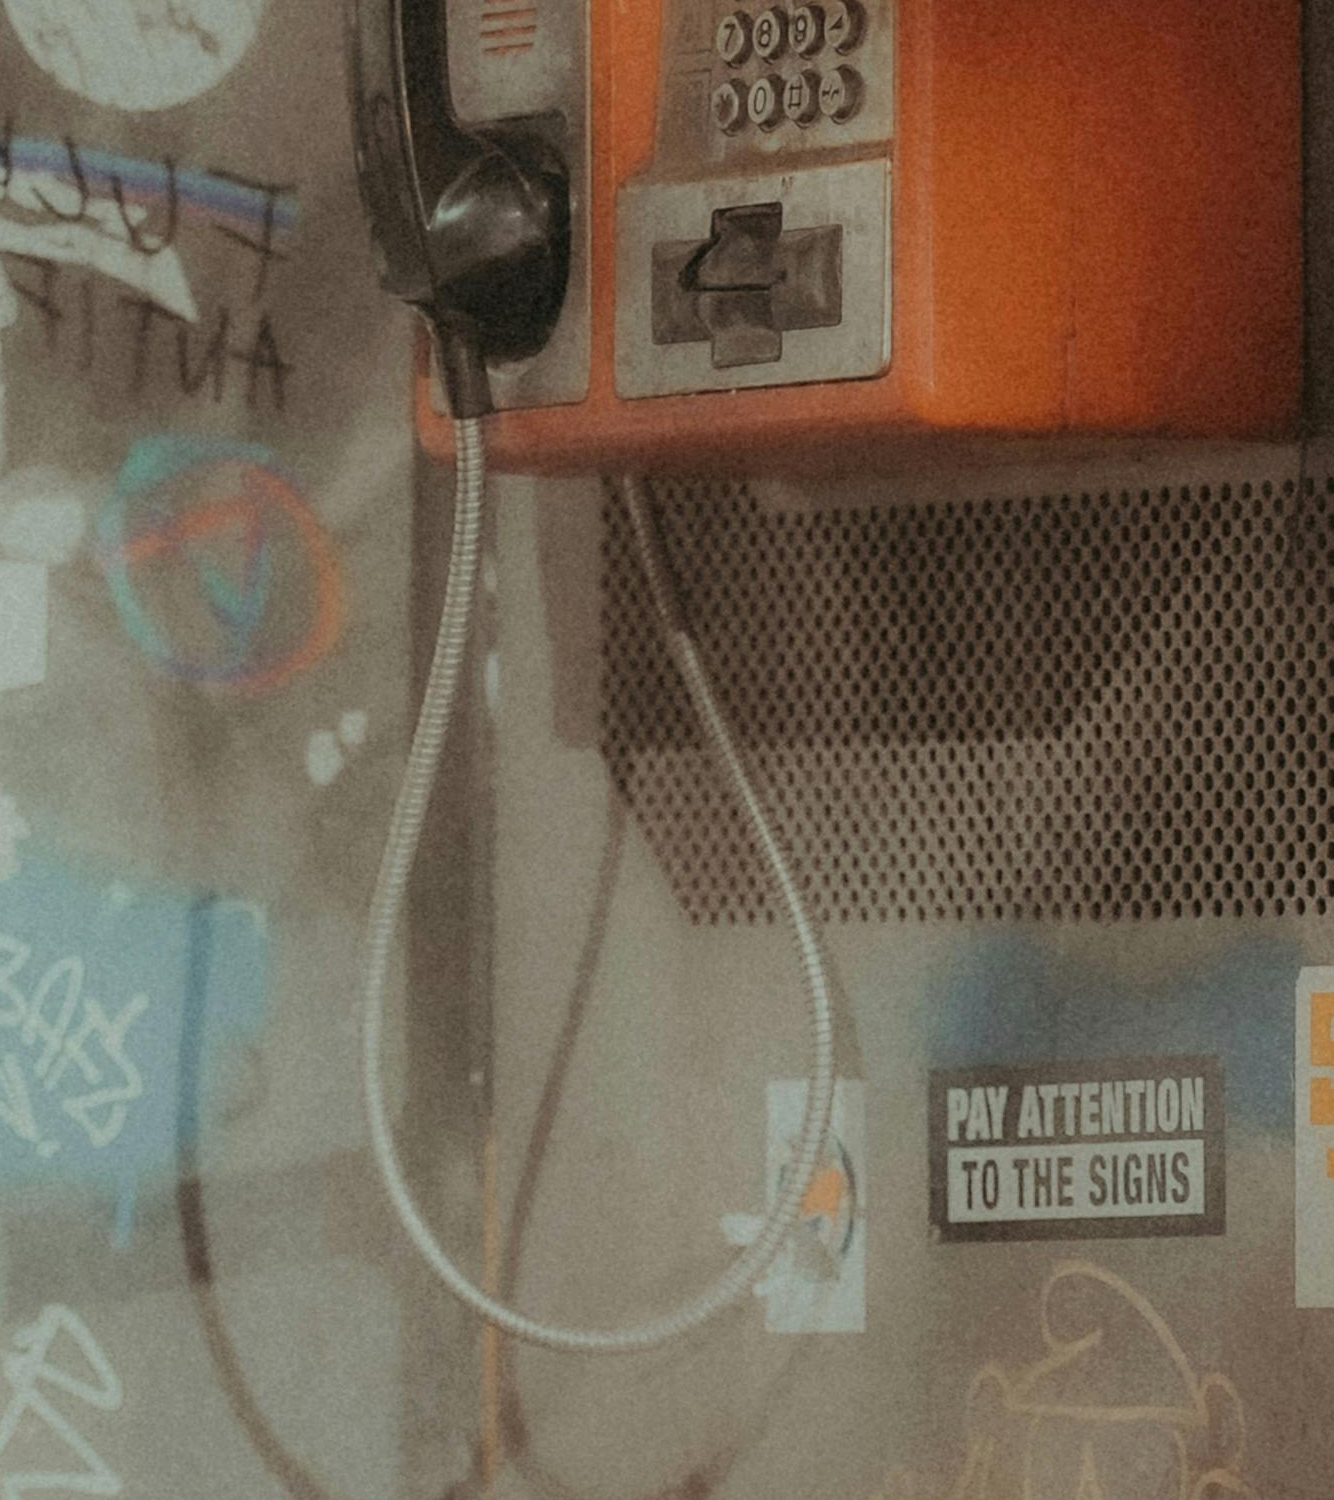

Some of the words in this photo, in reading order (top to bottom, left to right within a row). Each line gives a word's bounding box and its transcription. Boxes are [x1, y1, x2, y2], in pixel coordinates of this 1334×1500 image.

[947, 1086, 1008, 1141] PAY
[1019, 1077, 1204, 1138] ATTENTION
[962, 1159, 999, 1210] TO
[1013, 1157, 1073, 1208] THE
[1089, 1152, 1190, 1206] SIGNS
